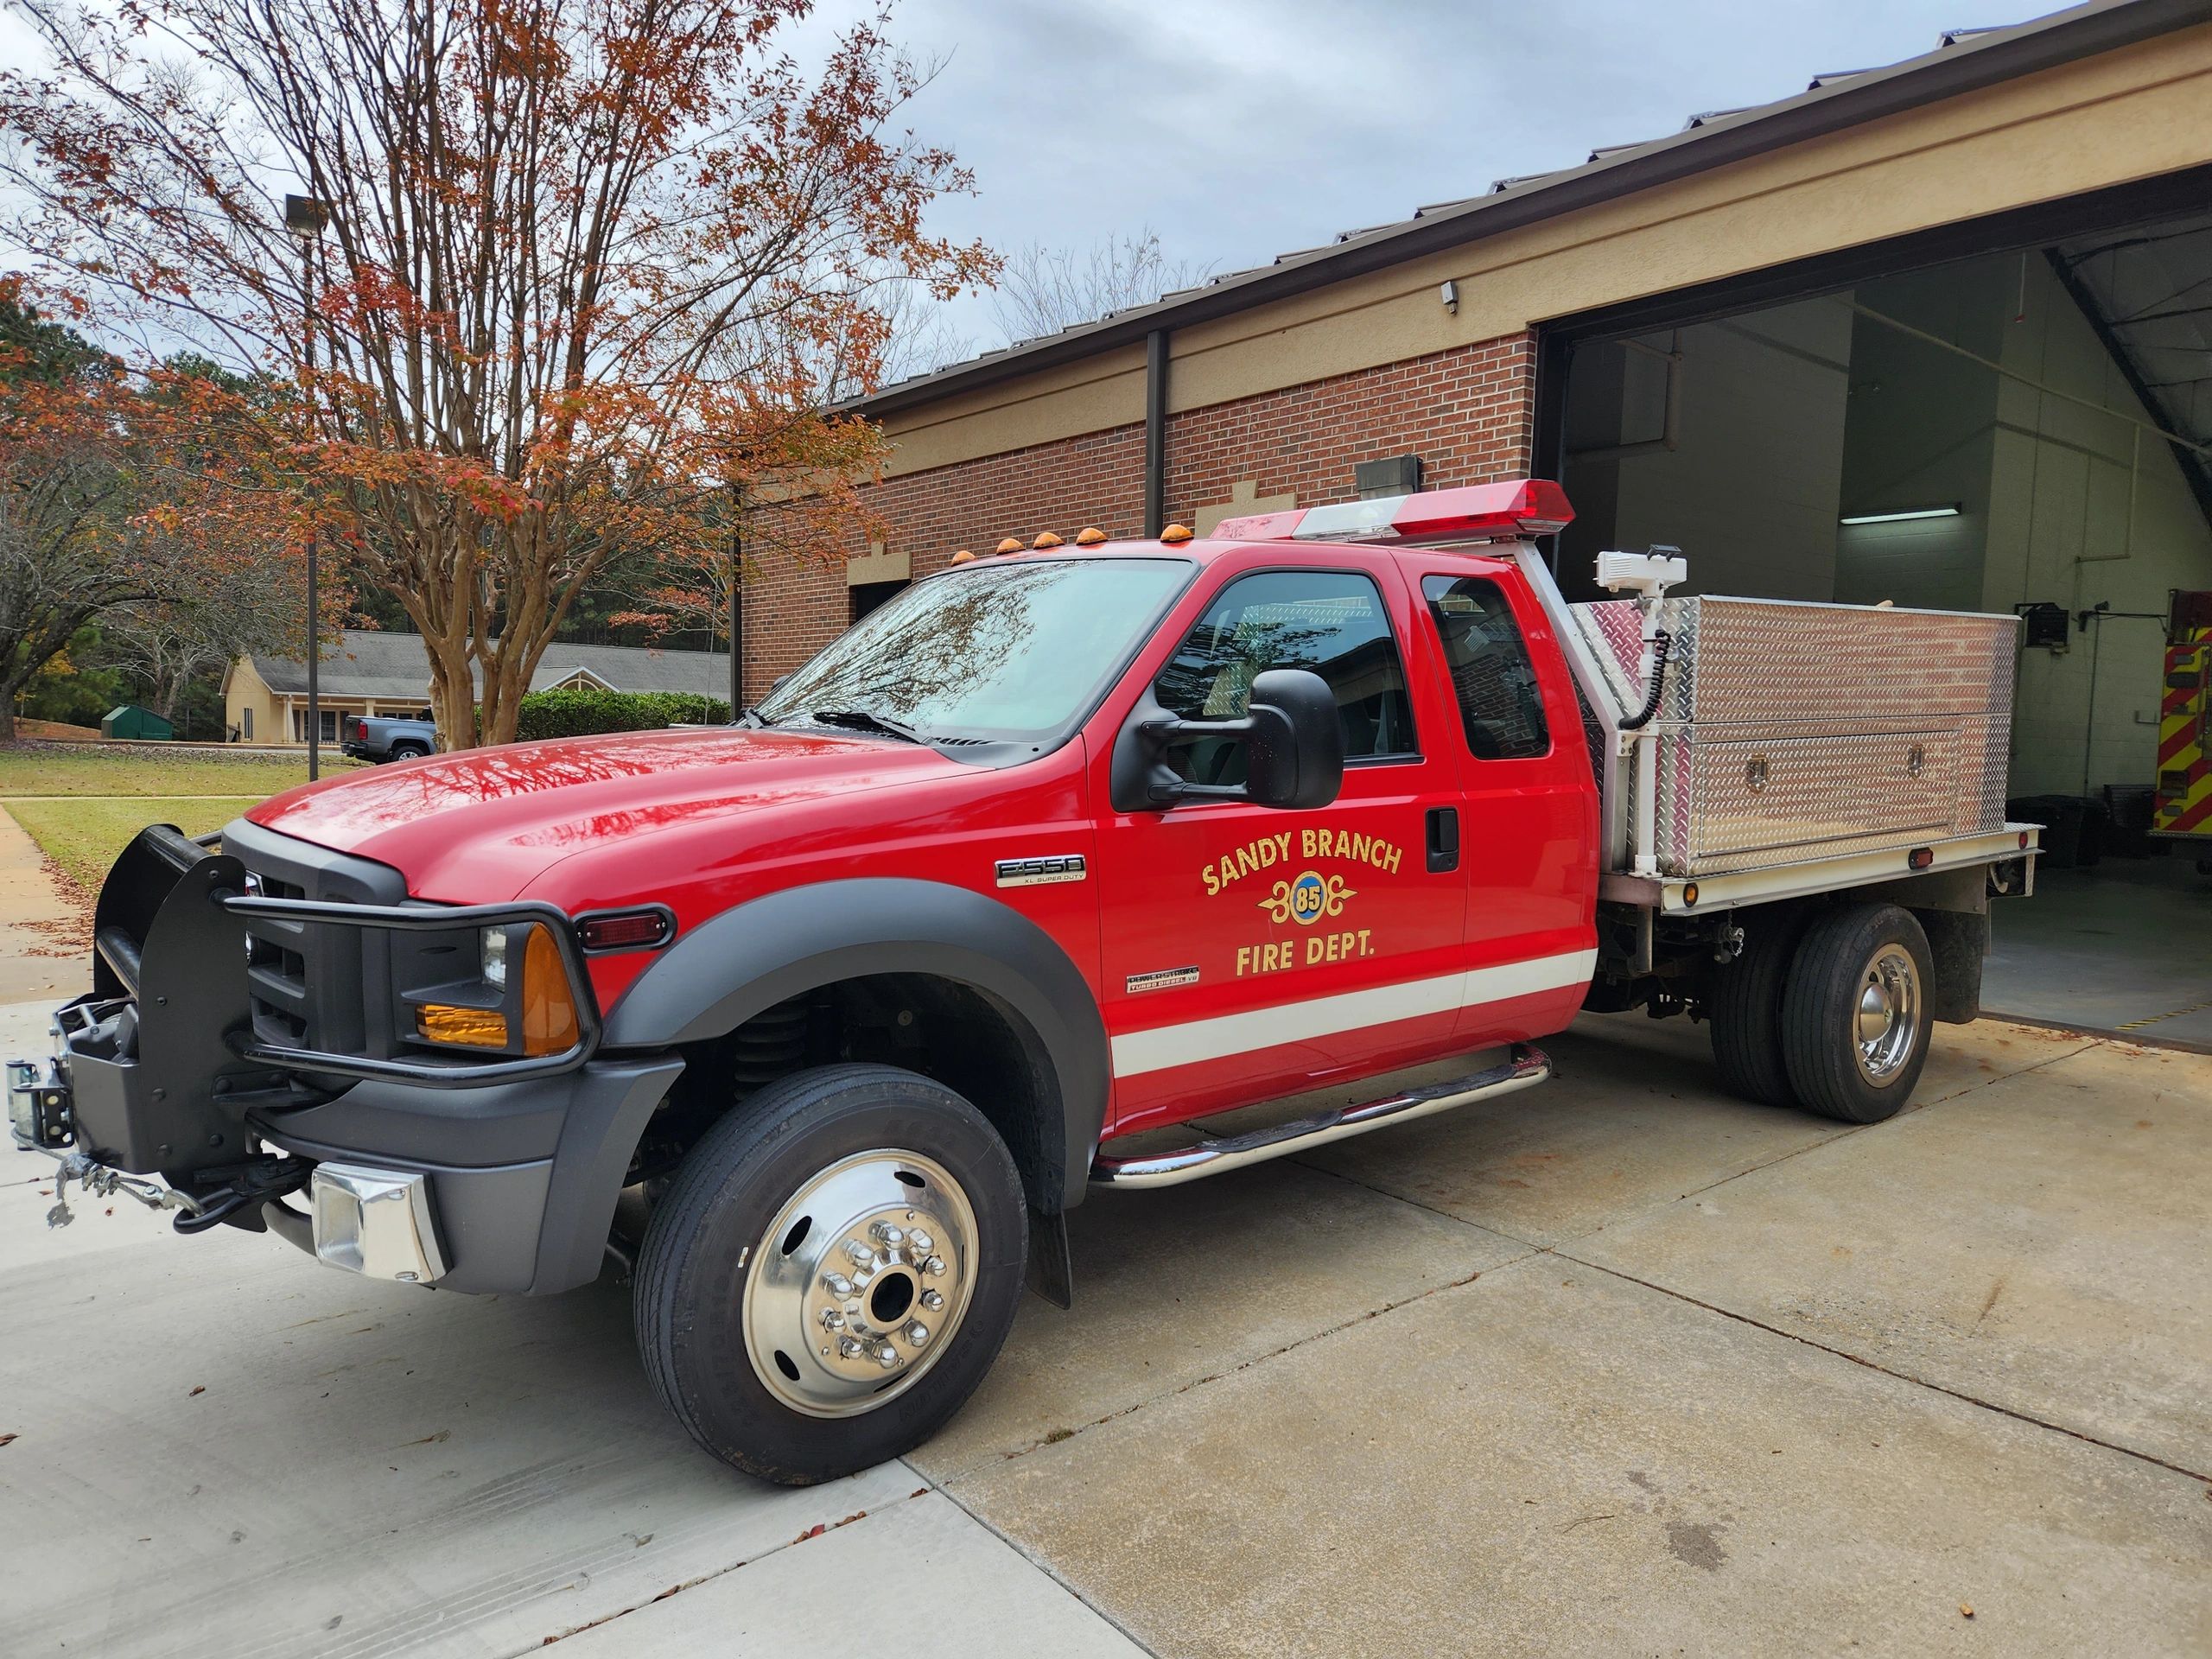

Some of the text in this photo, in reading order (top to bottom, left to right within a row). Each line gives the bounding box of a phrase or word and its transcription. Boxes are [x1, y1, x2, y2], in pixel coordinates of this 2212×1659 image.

[1202, 829, 1402, 896] SANDY BRANCH
[1295, 886, 1322, 913] 85
[1236, 929, 1375, 977] FIRE DEPT.
[1131, 982, 1157, 990] TURBO
[1158, 977, 1185, 986] DIESEL
